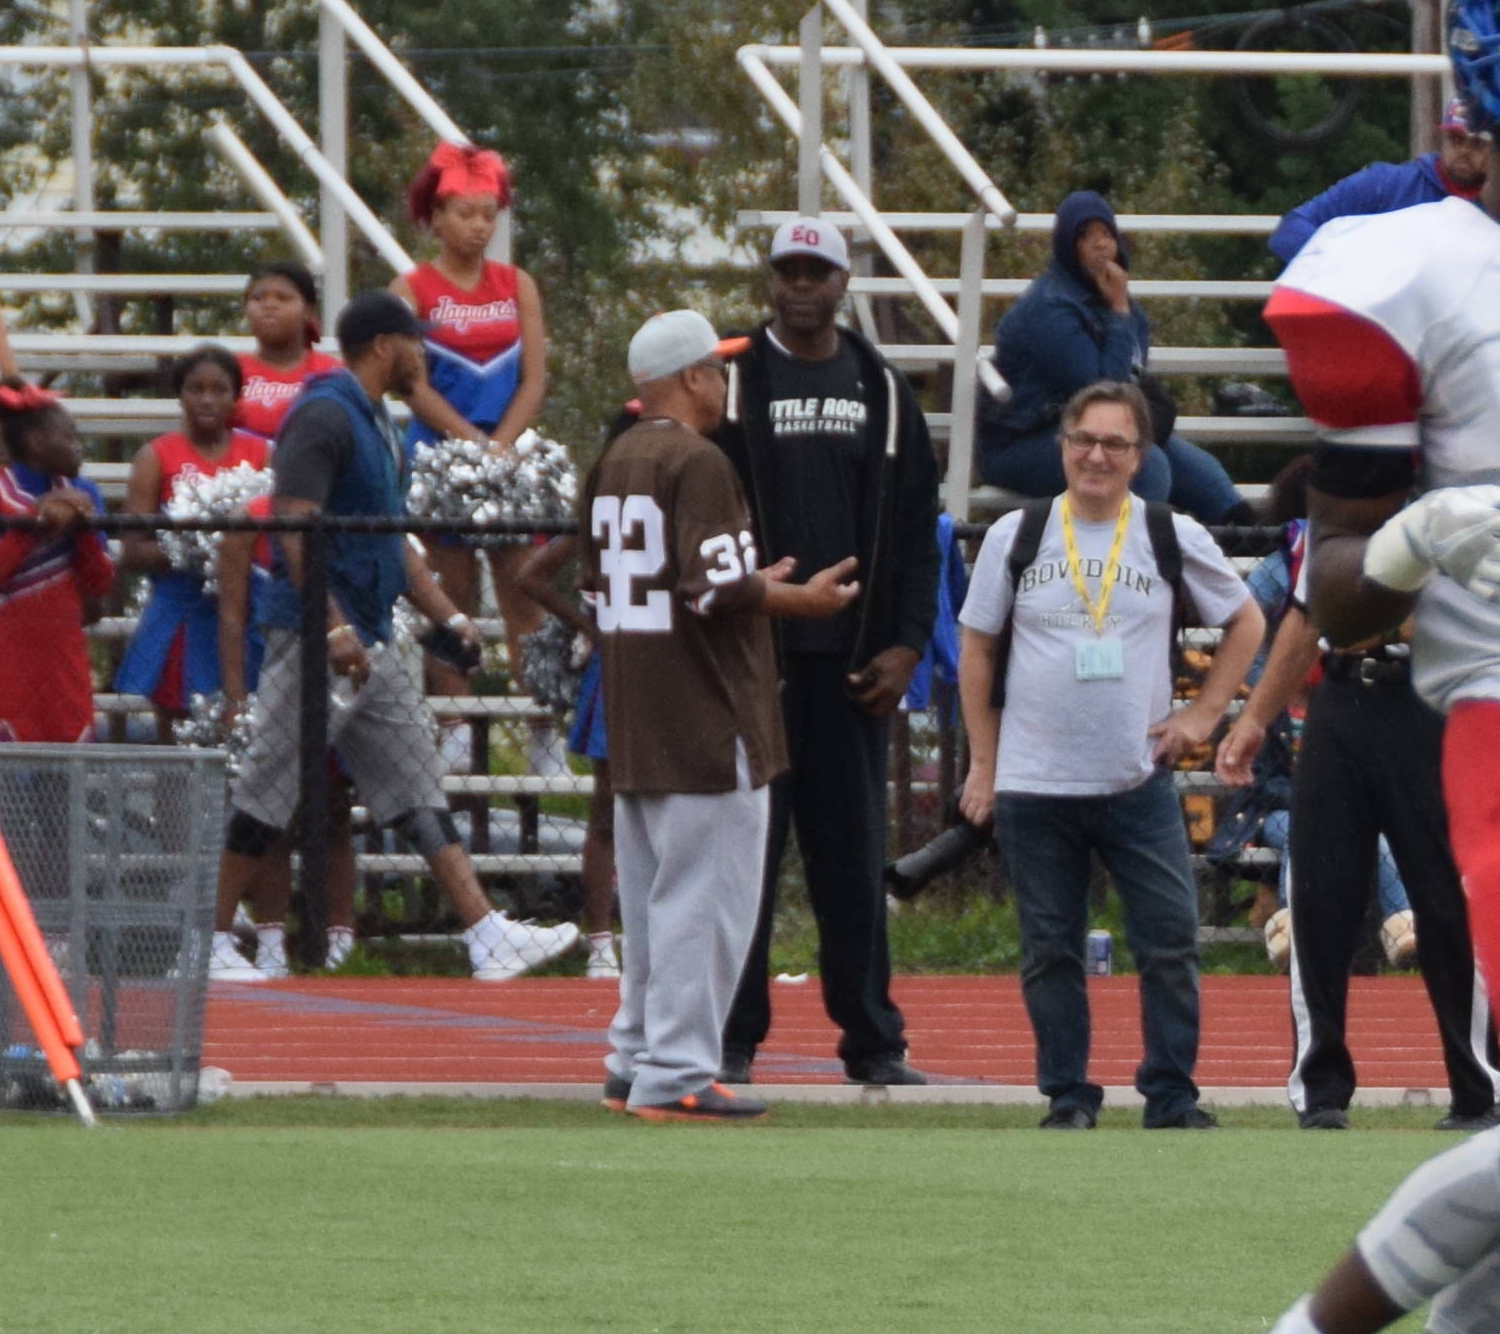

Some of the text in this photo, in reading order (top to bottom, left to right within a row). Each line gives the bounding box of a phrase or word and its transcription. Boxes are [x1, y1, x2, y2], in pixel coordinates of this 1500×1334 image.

[769, 397, 819, 420] TTLE
[774, 419, 857, 435] BASKETBALL
[591, 494, 672, 631] 32
[1041, 614, 1122, 628] HOCKY
